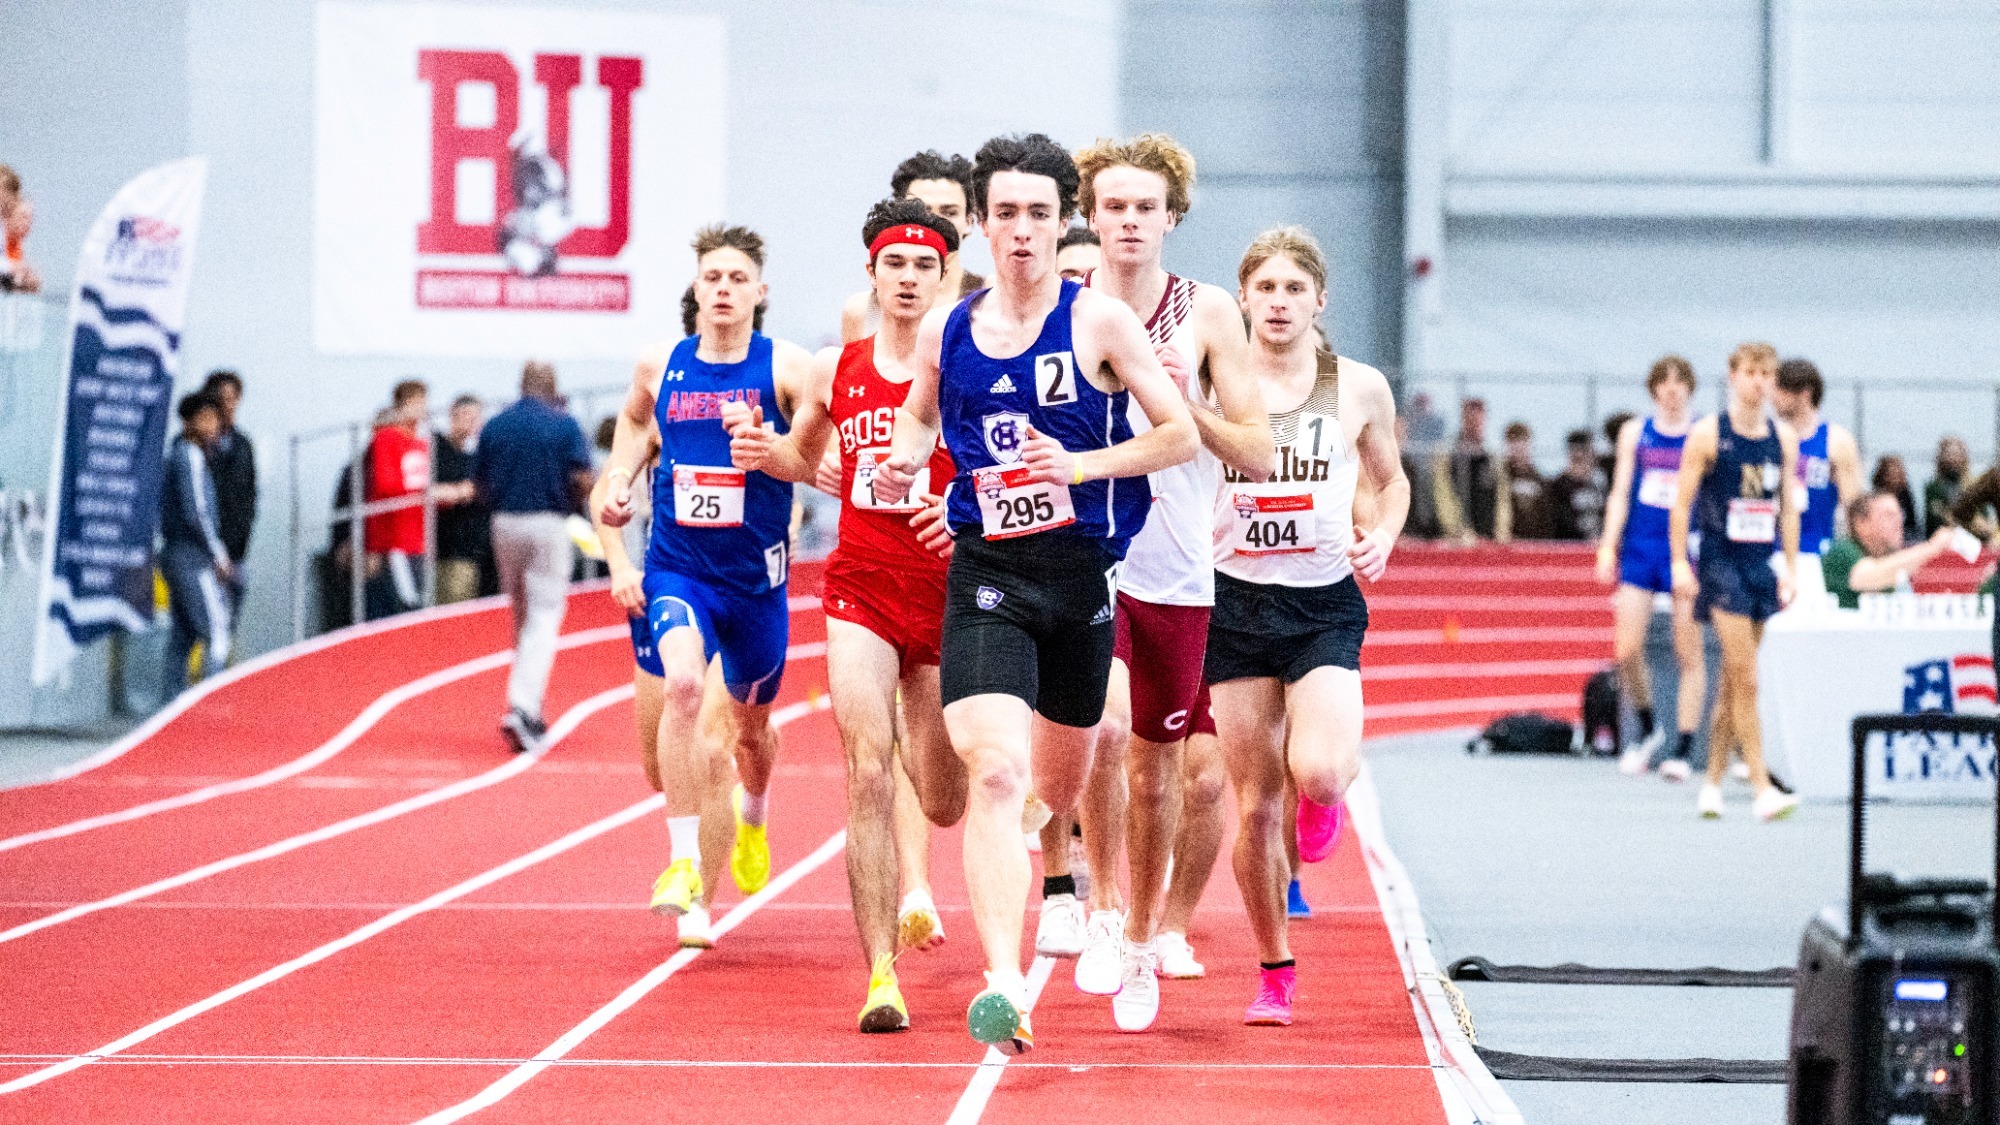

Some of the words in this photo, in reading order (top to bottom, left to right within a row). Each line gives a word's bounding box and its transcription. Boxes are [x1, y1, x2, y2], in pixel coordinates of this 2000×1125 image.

[417, 48, 642, 259] BU
[1043, 356, 1069, 402] 2
[1308, 417, 1323, 457] 1
[690, 494, 721, 519] 25
[996, 492, 1054, 529] 295
[1245, 520, 1299, 548] 404
[771, 546, 782, 584] 7
[1163, 709, 1188, 731] C
